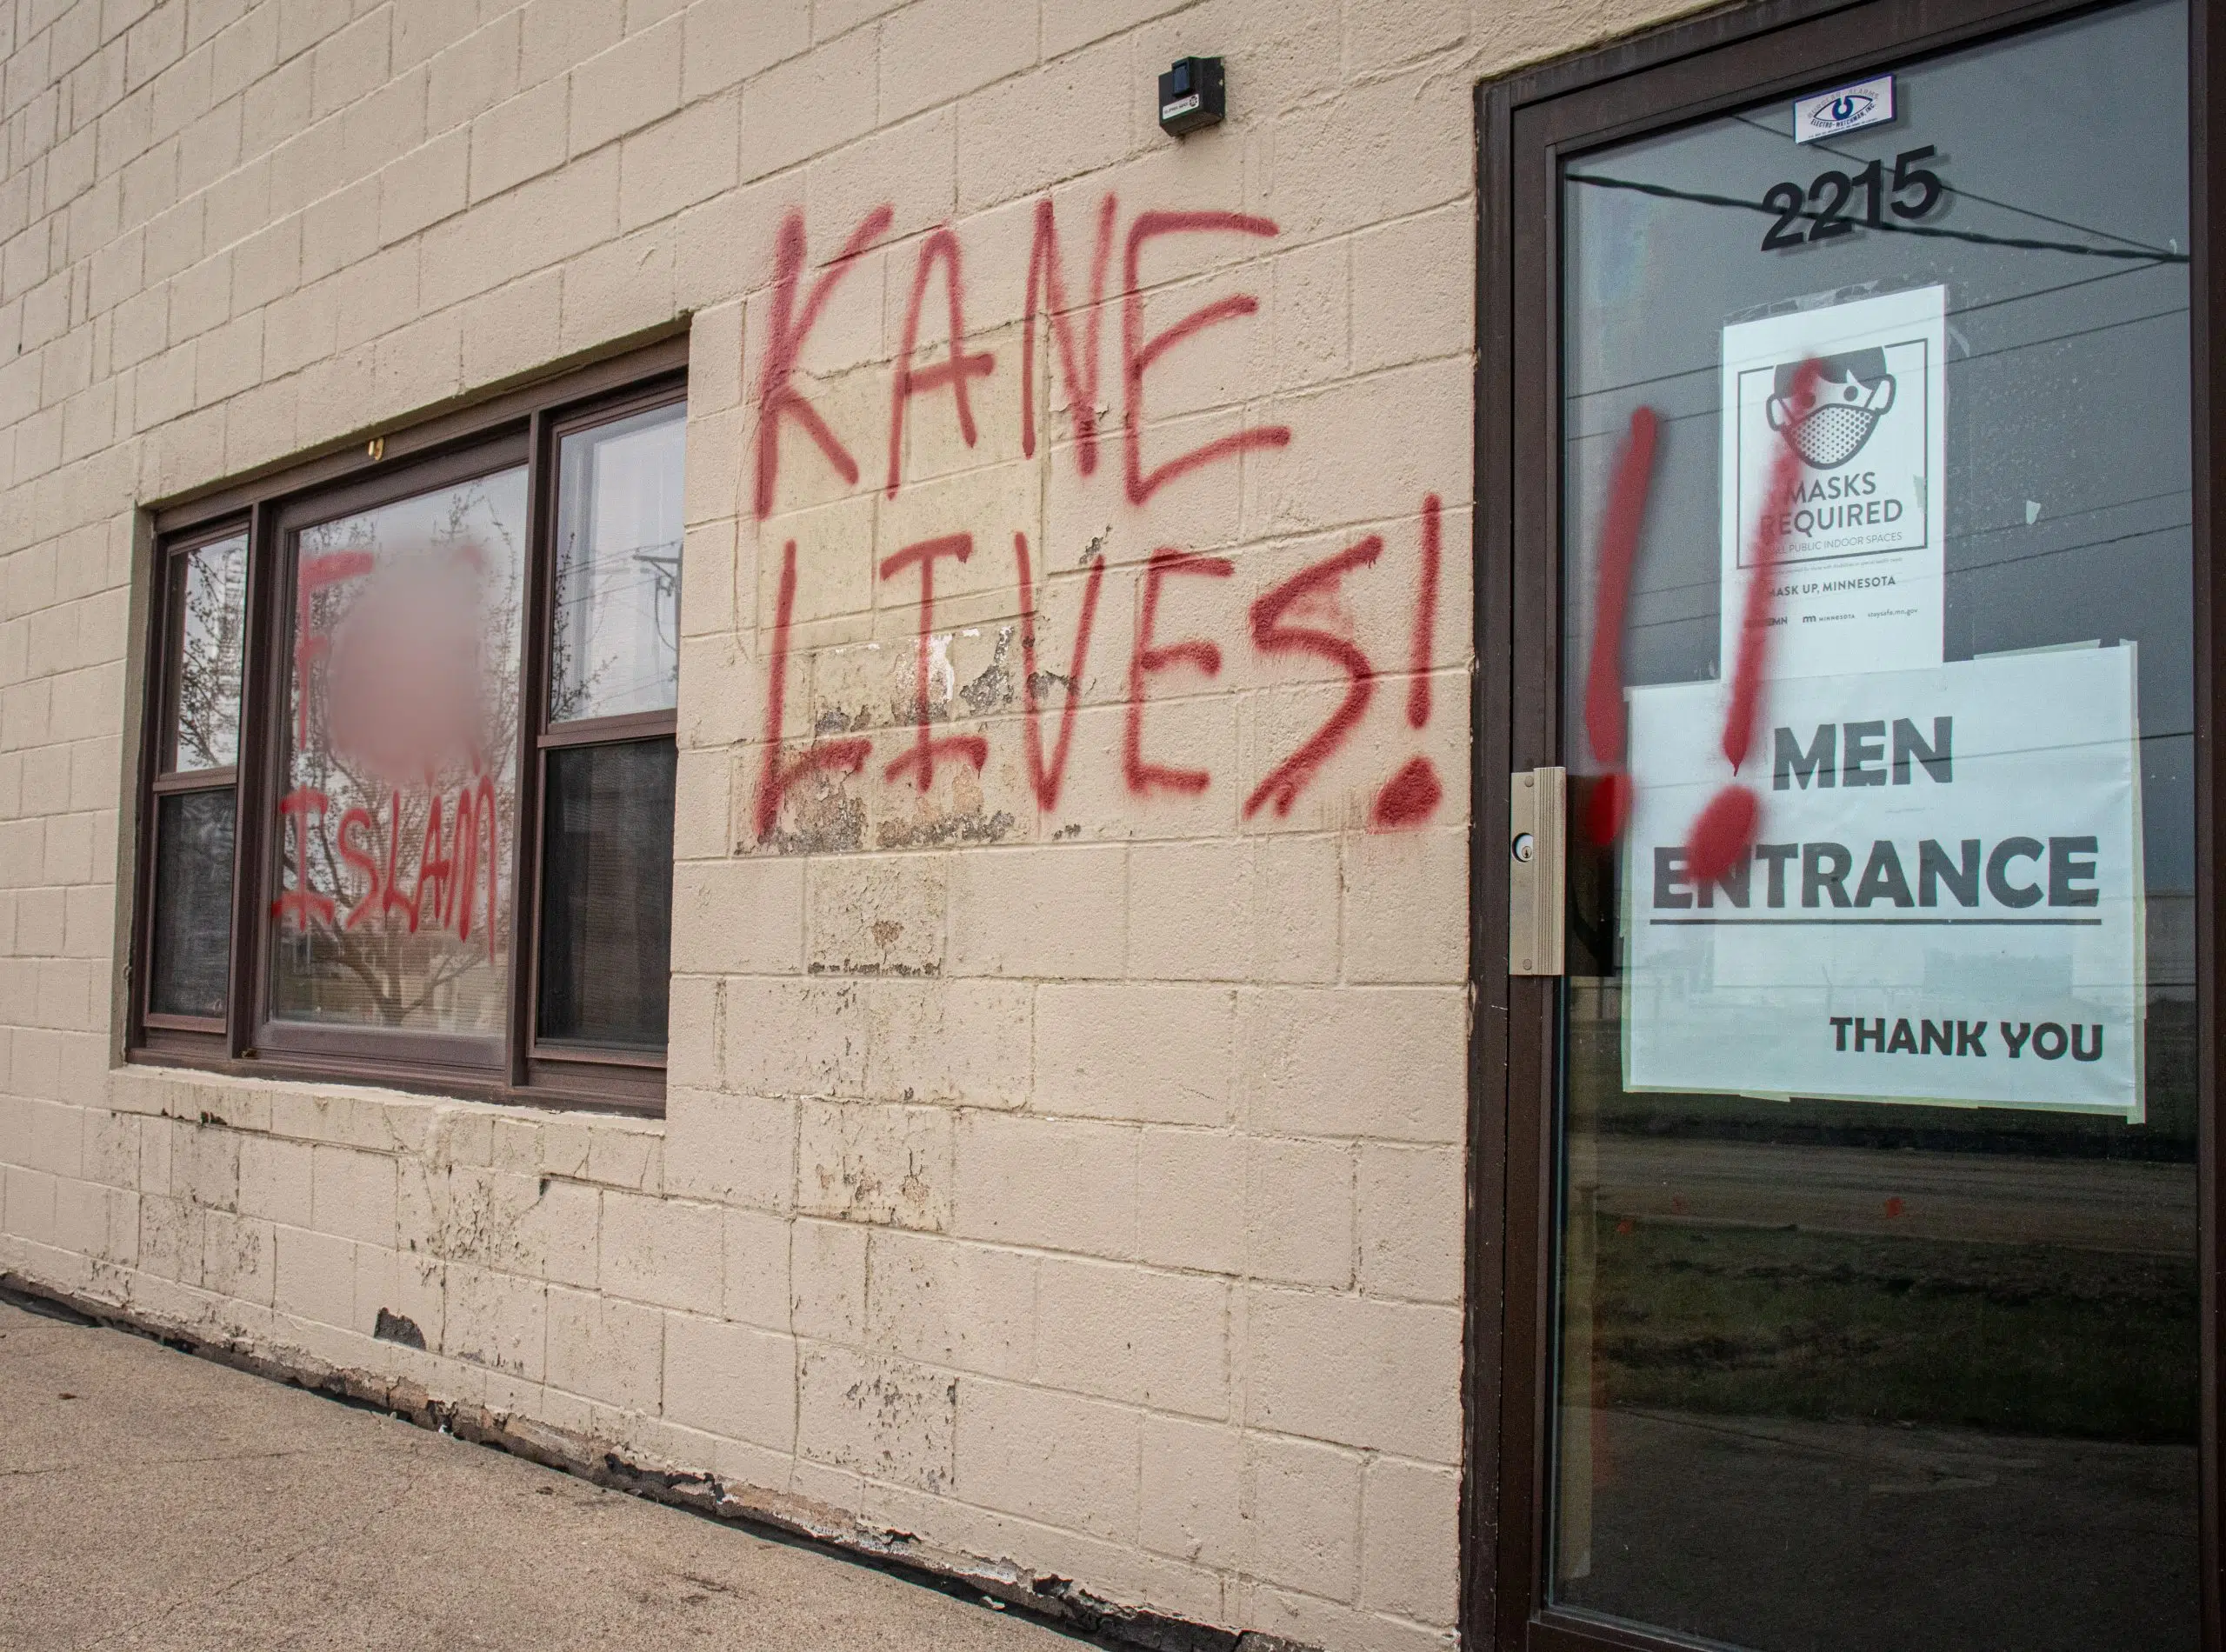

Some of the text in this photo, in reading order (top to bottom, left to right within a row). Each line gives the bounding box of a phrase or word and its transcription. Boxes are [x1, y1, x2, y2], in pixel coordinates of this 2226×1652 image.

[1761, 144, 1941, 251] 2215
[753, 192, 1292, 522] KANE
[1761, 498, 1903, 537] REQUIRED
[1786, 471, 1876, 505] MASKS
[1789, 541, 1822, 553] PUBLIC
[1823, 536, 1864, 549] INDOOR
[1866, 531, 1903, 544] SPACES
[1803, 583, 1820, 595] UP,
[1822, 576, 1896, 592] MINNESOTA
[754, 492, 1443, 839] LIVES!
[1772, 716, 1953, 790] MEN
[271, 775, 497, 963] ISLAM
[1653, 836, 2100, 909] ENTRANCE
[1829, 1016, 2103, 1062] THANK YOU
